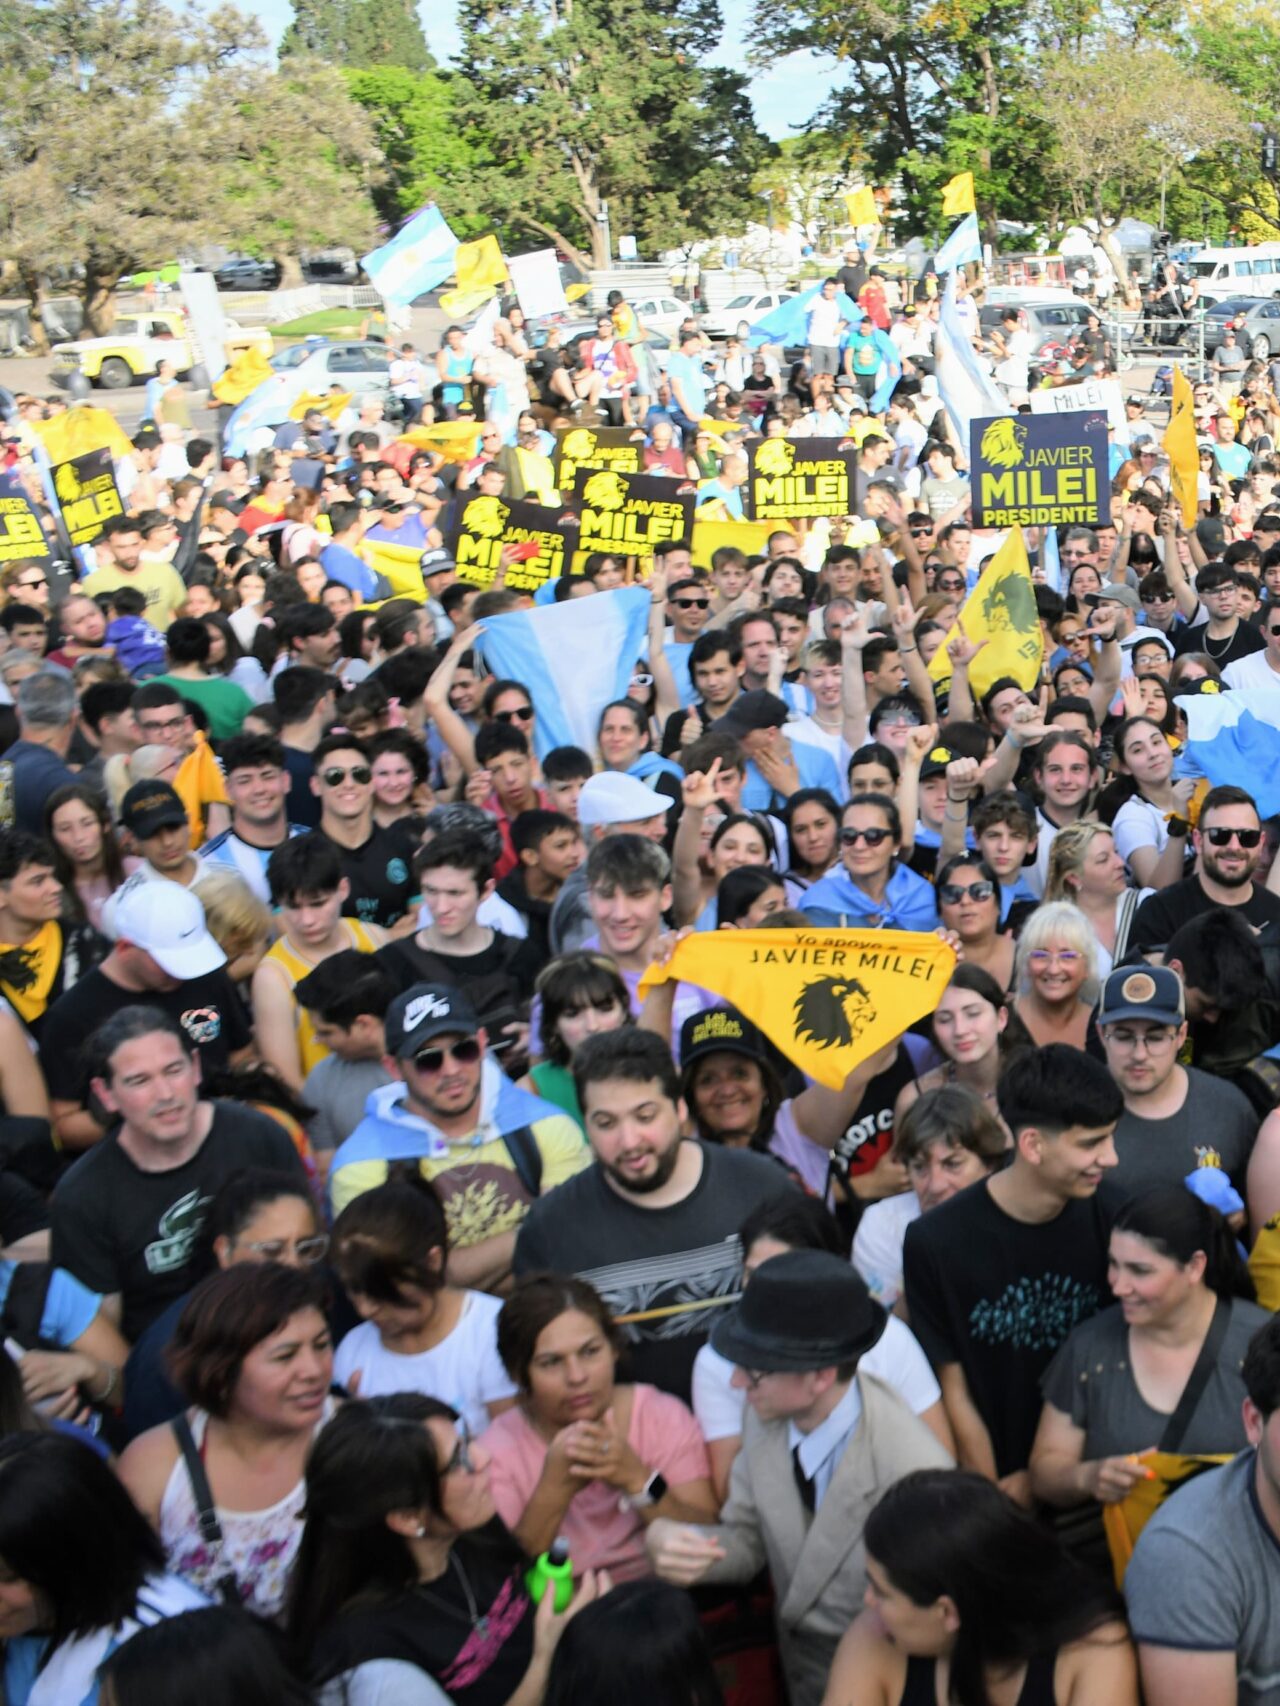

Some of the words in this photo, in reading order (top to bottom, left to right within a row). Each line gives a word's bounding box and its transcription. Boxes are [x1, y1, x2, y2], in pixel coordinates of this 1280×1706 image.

[592, 447, 638, 460] JAVIER
[1024, 445, 1093, 468] JAVIER
[791, 460, 846, 476] JAVIER
[755, 475, 849, 506] MILEI
[981, 467, 1098, 507] MILEI
[61, 488, 124, 532] MILEI
[622, 499, 684, 519] JAVIER
[756, 502, 849, 519] PRESIDENTE
[983, 505, 1099, 527] PRESIDENTE
[580, 508, 685, 544] MILEI
[795, 934, 816, 946] Yo
[824, 937, 883, 950] apoyo
[750, 949, 846, 966] JAVIER
[858, 952, 936, 982] MILEI
